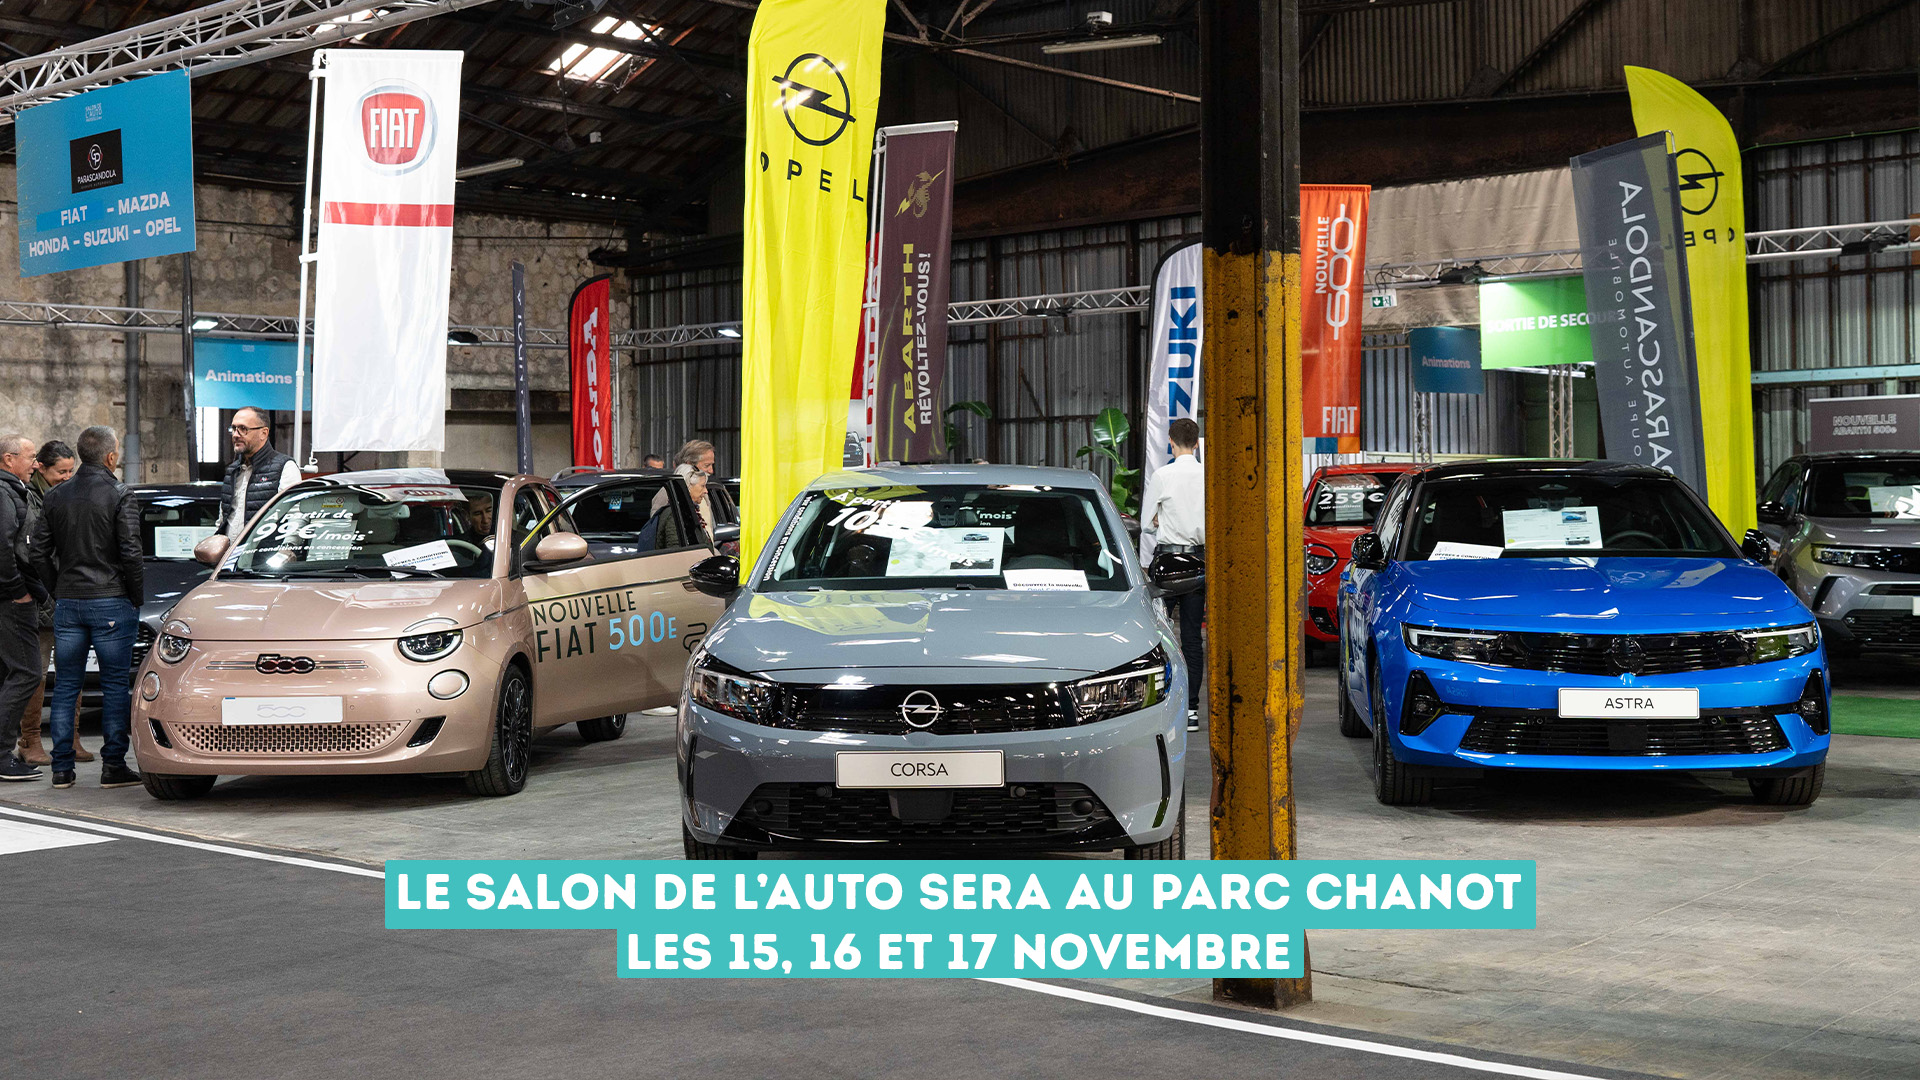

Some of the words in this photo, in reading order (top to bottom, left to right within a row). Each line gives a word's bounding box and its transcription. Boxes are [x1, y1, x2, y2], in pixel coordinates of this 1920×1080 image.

[370, 108, 420, 149] FIAT
[77, 169, 117, 184] PARASCANDOLA
[60, 205, 88, 226] FIAT
[118, 191, 171, 216] MAZDA
[29, 236, 70, 257] HONDA
[83, 224, 129, 248] SUZUKI
[145, 217, 182, 238] OPEL
[1315, 216, 1330, 294] NOUVELLE
[1486, 316, 1535, 333] SORTIE
[1537, 315, 1558, 329] DE
[902, 243, 916, 434] ABARTH
[1422, 355, 1471, 369] Animations
[205, 369, 293, 384] Animations
[1166, 286, 1198, 464] ZUKI
[583, 307, 604, 471] ONDA
[1322, 406, 1358, 434] FIAT
[1832, 413, 1897, 427] NOUVELLE
[1832, 426, 1872, 435] ABARTH
[830, 489, 853, 502] À
[264, 508, 281, 522] À
[280, 509, 330, 523] partir
[333, 509, 353, 519] de
[532, 591, 637, 626] NOUVELLE
[536, 622, 597, 663] FIAT
[256, 654, 315, 674] 500
[257, 704, 306, 718] 500
[1604, 698, 1654, 709] ASTRA
[891, 763, 949, 777] CORSA
